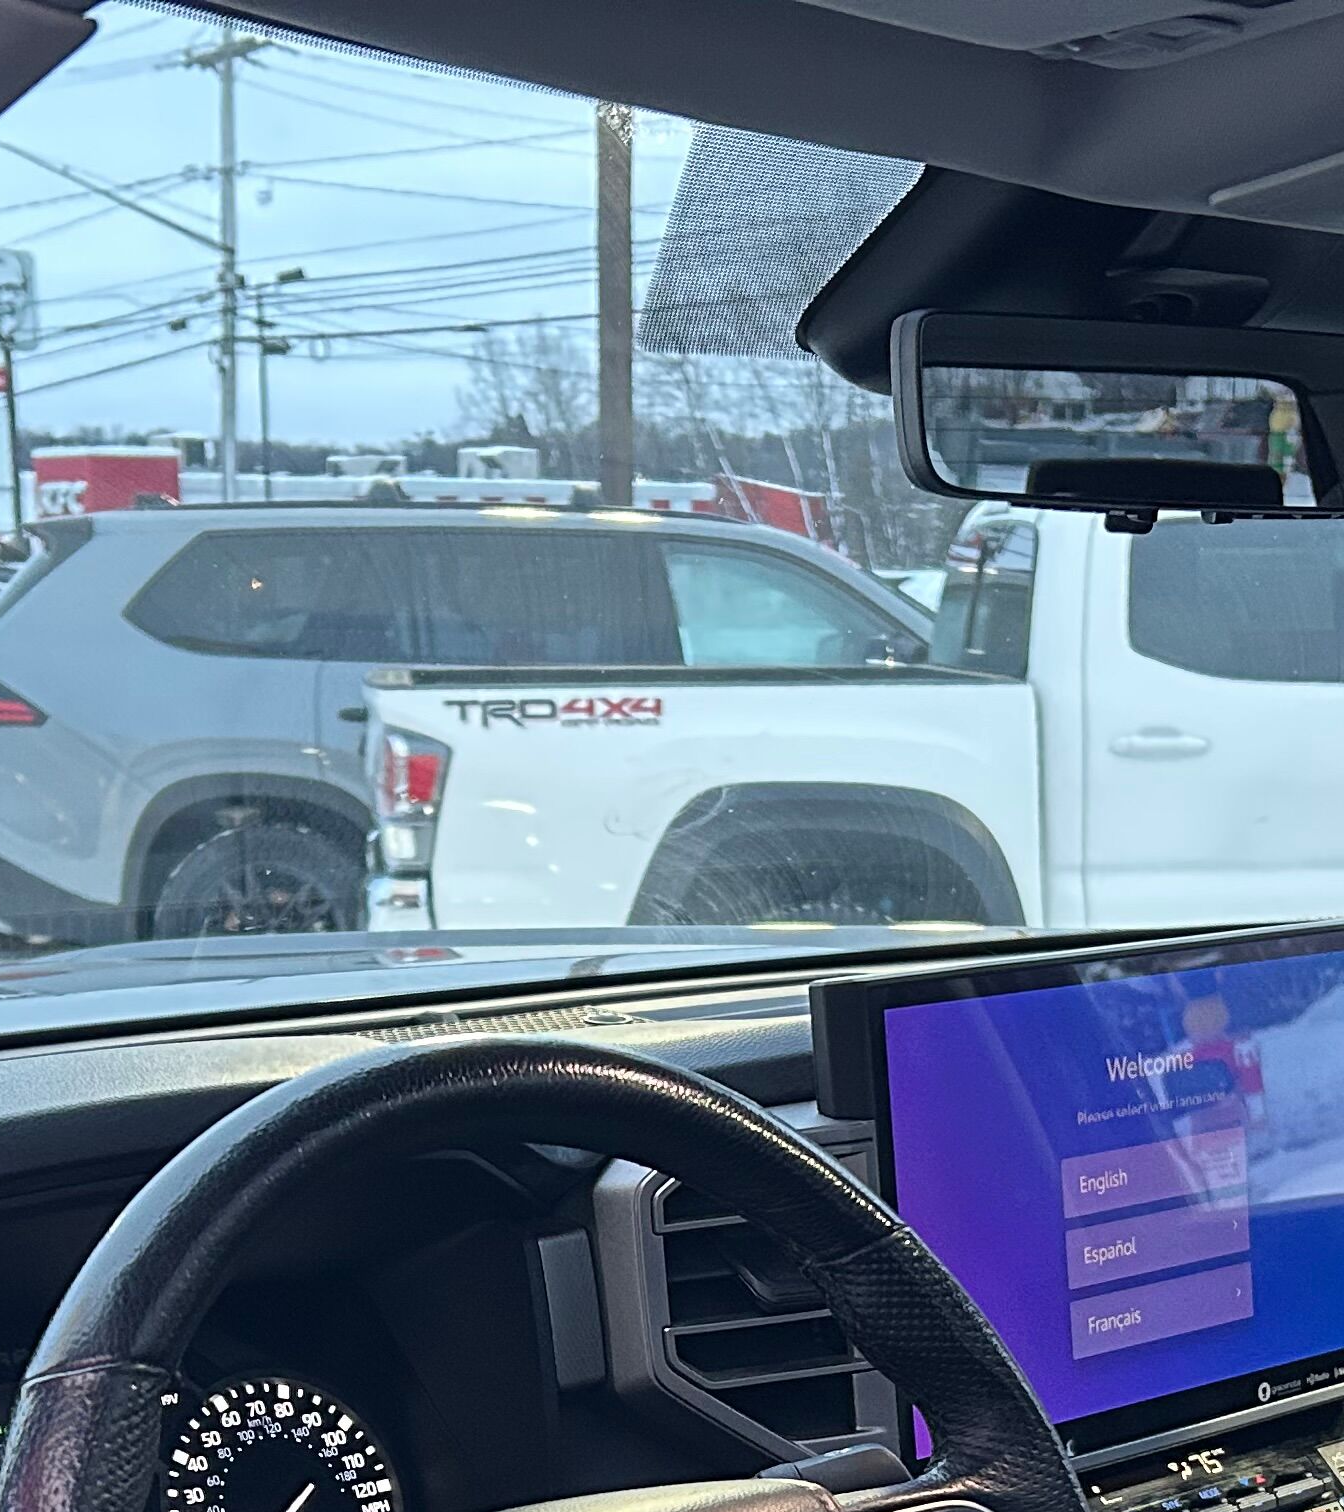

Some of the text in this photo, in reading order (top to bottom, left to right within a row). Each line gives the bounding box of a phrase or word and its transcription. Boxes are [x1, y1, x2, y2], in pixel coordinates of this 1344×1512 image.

[443, 699, 556, 729] TRD
[1106, 1052, 1194, 1083] Welcome
[1079, 1168, 1128, 1195] English
[1084, 1236, 1137, 1266] Español
[1088, 1308, 1142, 1335] Français
[245, 1400, 266, 1417] 70
[273, 1401, 295, 1418] 80
[221, 1410, 242, 1427] 60
[246, 1416, 273, 1429] km/h
[301, 1411, 322, 1429] 90
[236, 1429, 255, 1442] 100
[263, 1422, 282, 1435] 120
[291, 1426, 310, 1438] 140
[201, 1431, 222, 1448] 50
[321, 1430, 347, 1448] 100
[218, 1447, 232, 1459] 80
[321, 1446, 339, 1458] 160
[187, 1456, 208, 1472] 40
[341, 1452, 365, 1470] 110
[206, 1475, 221, 1486] 60
[339, 1469, 357, 1481] 180
[183, 1487, 205, 1505] 30
[351, 1481, 377, 1499] 120
